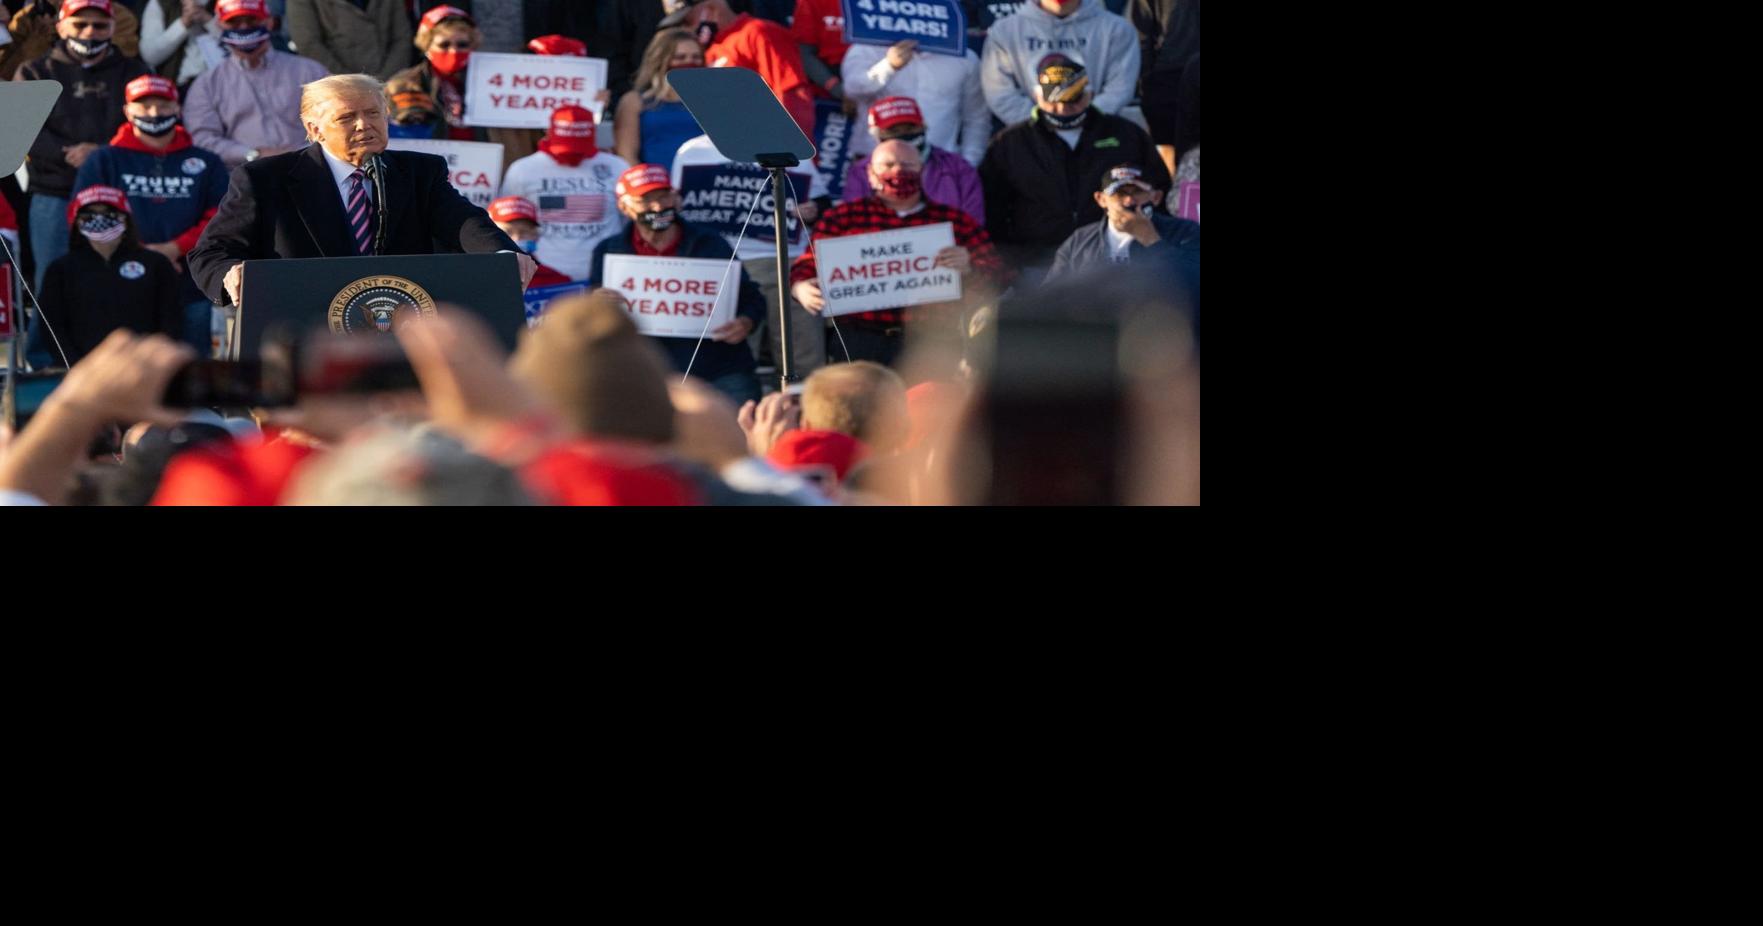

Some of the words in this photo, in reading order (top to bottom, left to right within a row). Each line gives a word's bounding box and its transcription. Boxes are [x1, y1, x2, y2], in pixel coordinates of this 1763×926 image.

[878, 0, 949, 20] MORE
[861, 14, 948, 38] YEARS!
[489, 73, 504, 87] 4
[512, 75, 586, 91] MORE
[121, 174, 195, 188] TRUMP
[537, 177, 607, 193] JESUS
[714, 175, 767, 191] MAKE
[737, 212, 798, 231] AGAN
[860, 241, 914, 258] MAKE
[622, 277, 635, 291] 4
[644, 278, 719, 295] MORE
[829, 281, 889, 299] GREAT
[894, 273, 952, 291] AGAIN
[332, 279, 379, 317] PRESIDENT
[394, 280, 408, 289] THE
[624, 299, 713, 317] YEARS!
